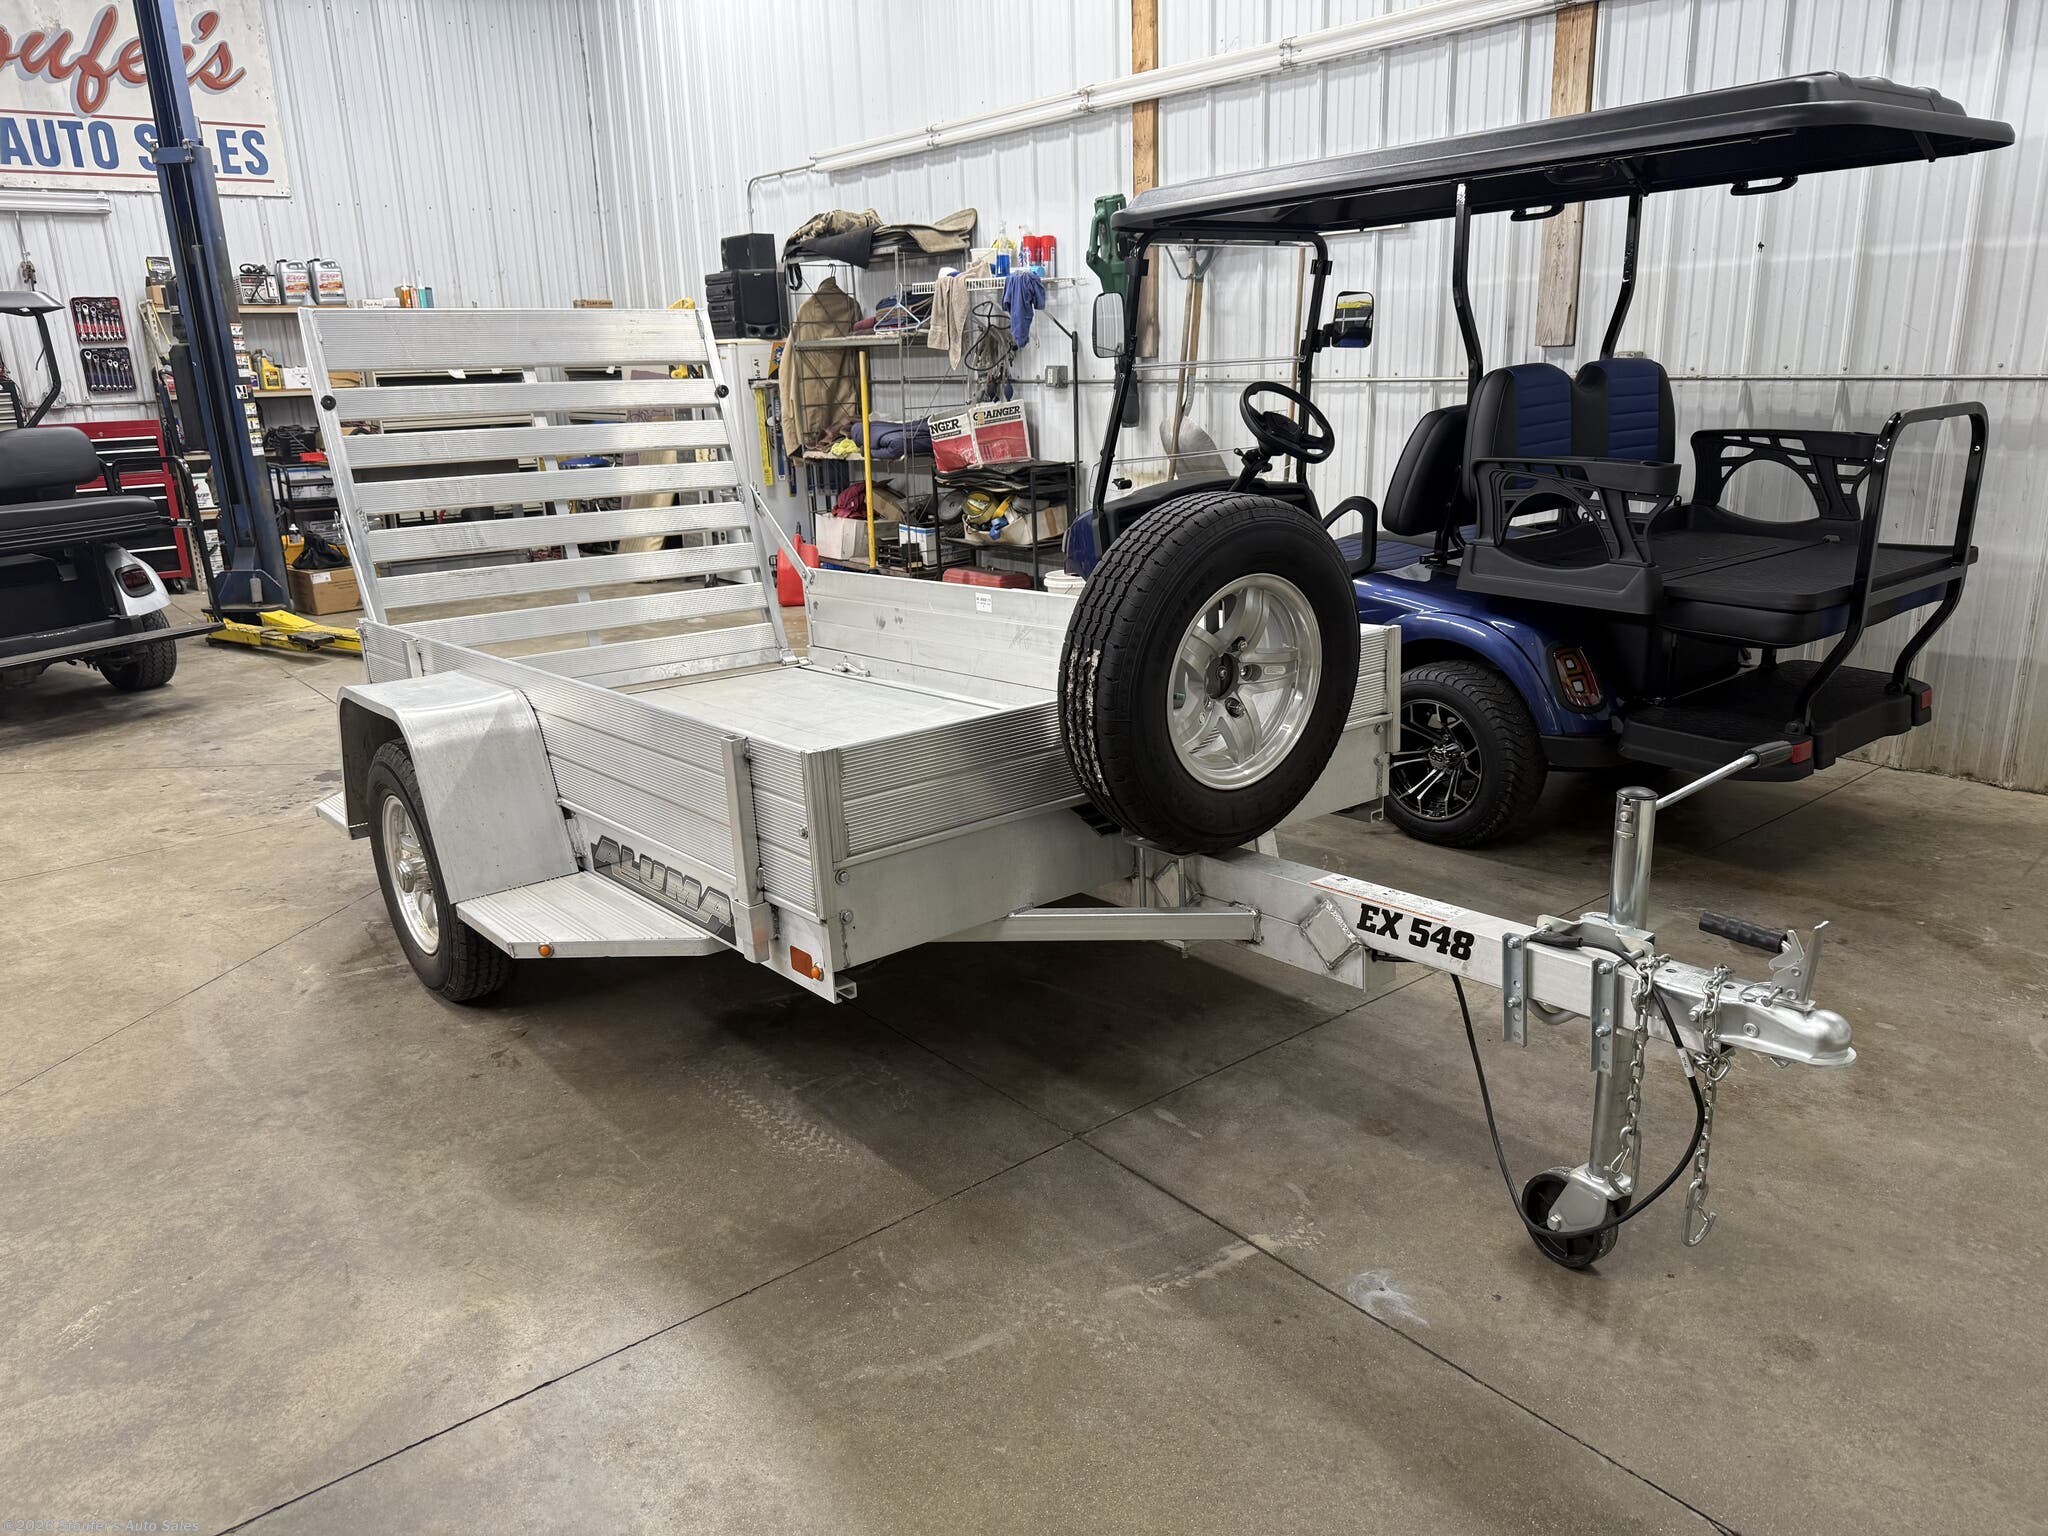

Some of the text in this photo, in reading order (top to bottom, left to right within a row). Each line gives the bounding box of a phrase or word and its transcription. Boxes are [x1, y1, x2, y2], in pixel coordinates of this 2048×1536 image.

[0, 117, 120, 170] AUTO
[593, 834, 732, 928] ALUMA
[1356, 903, 1476, 961] EX 548
